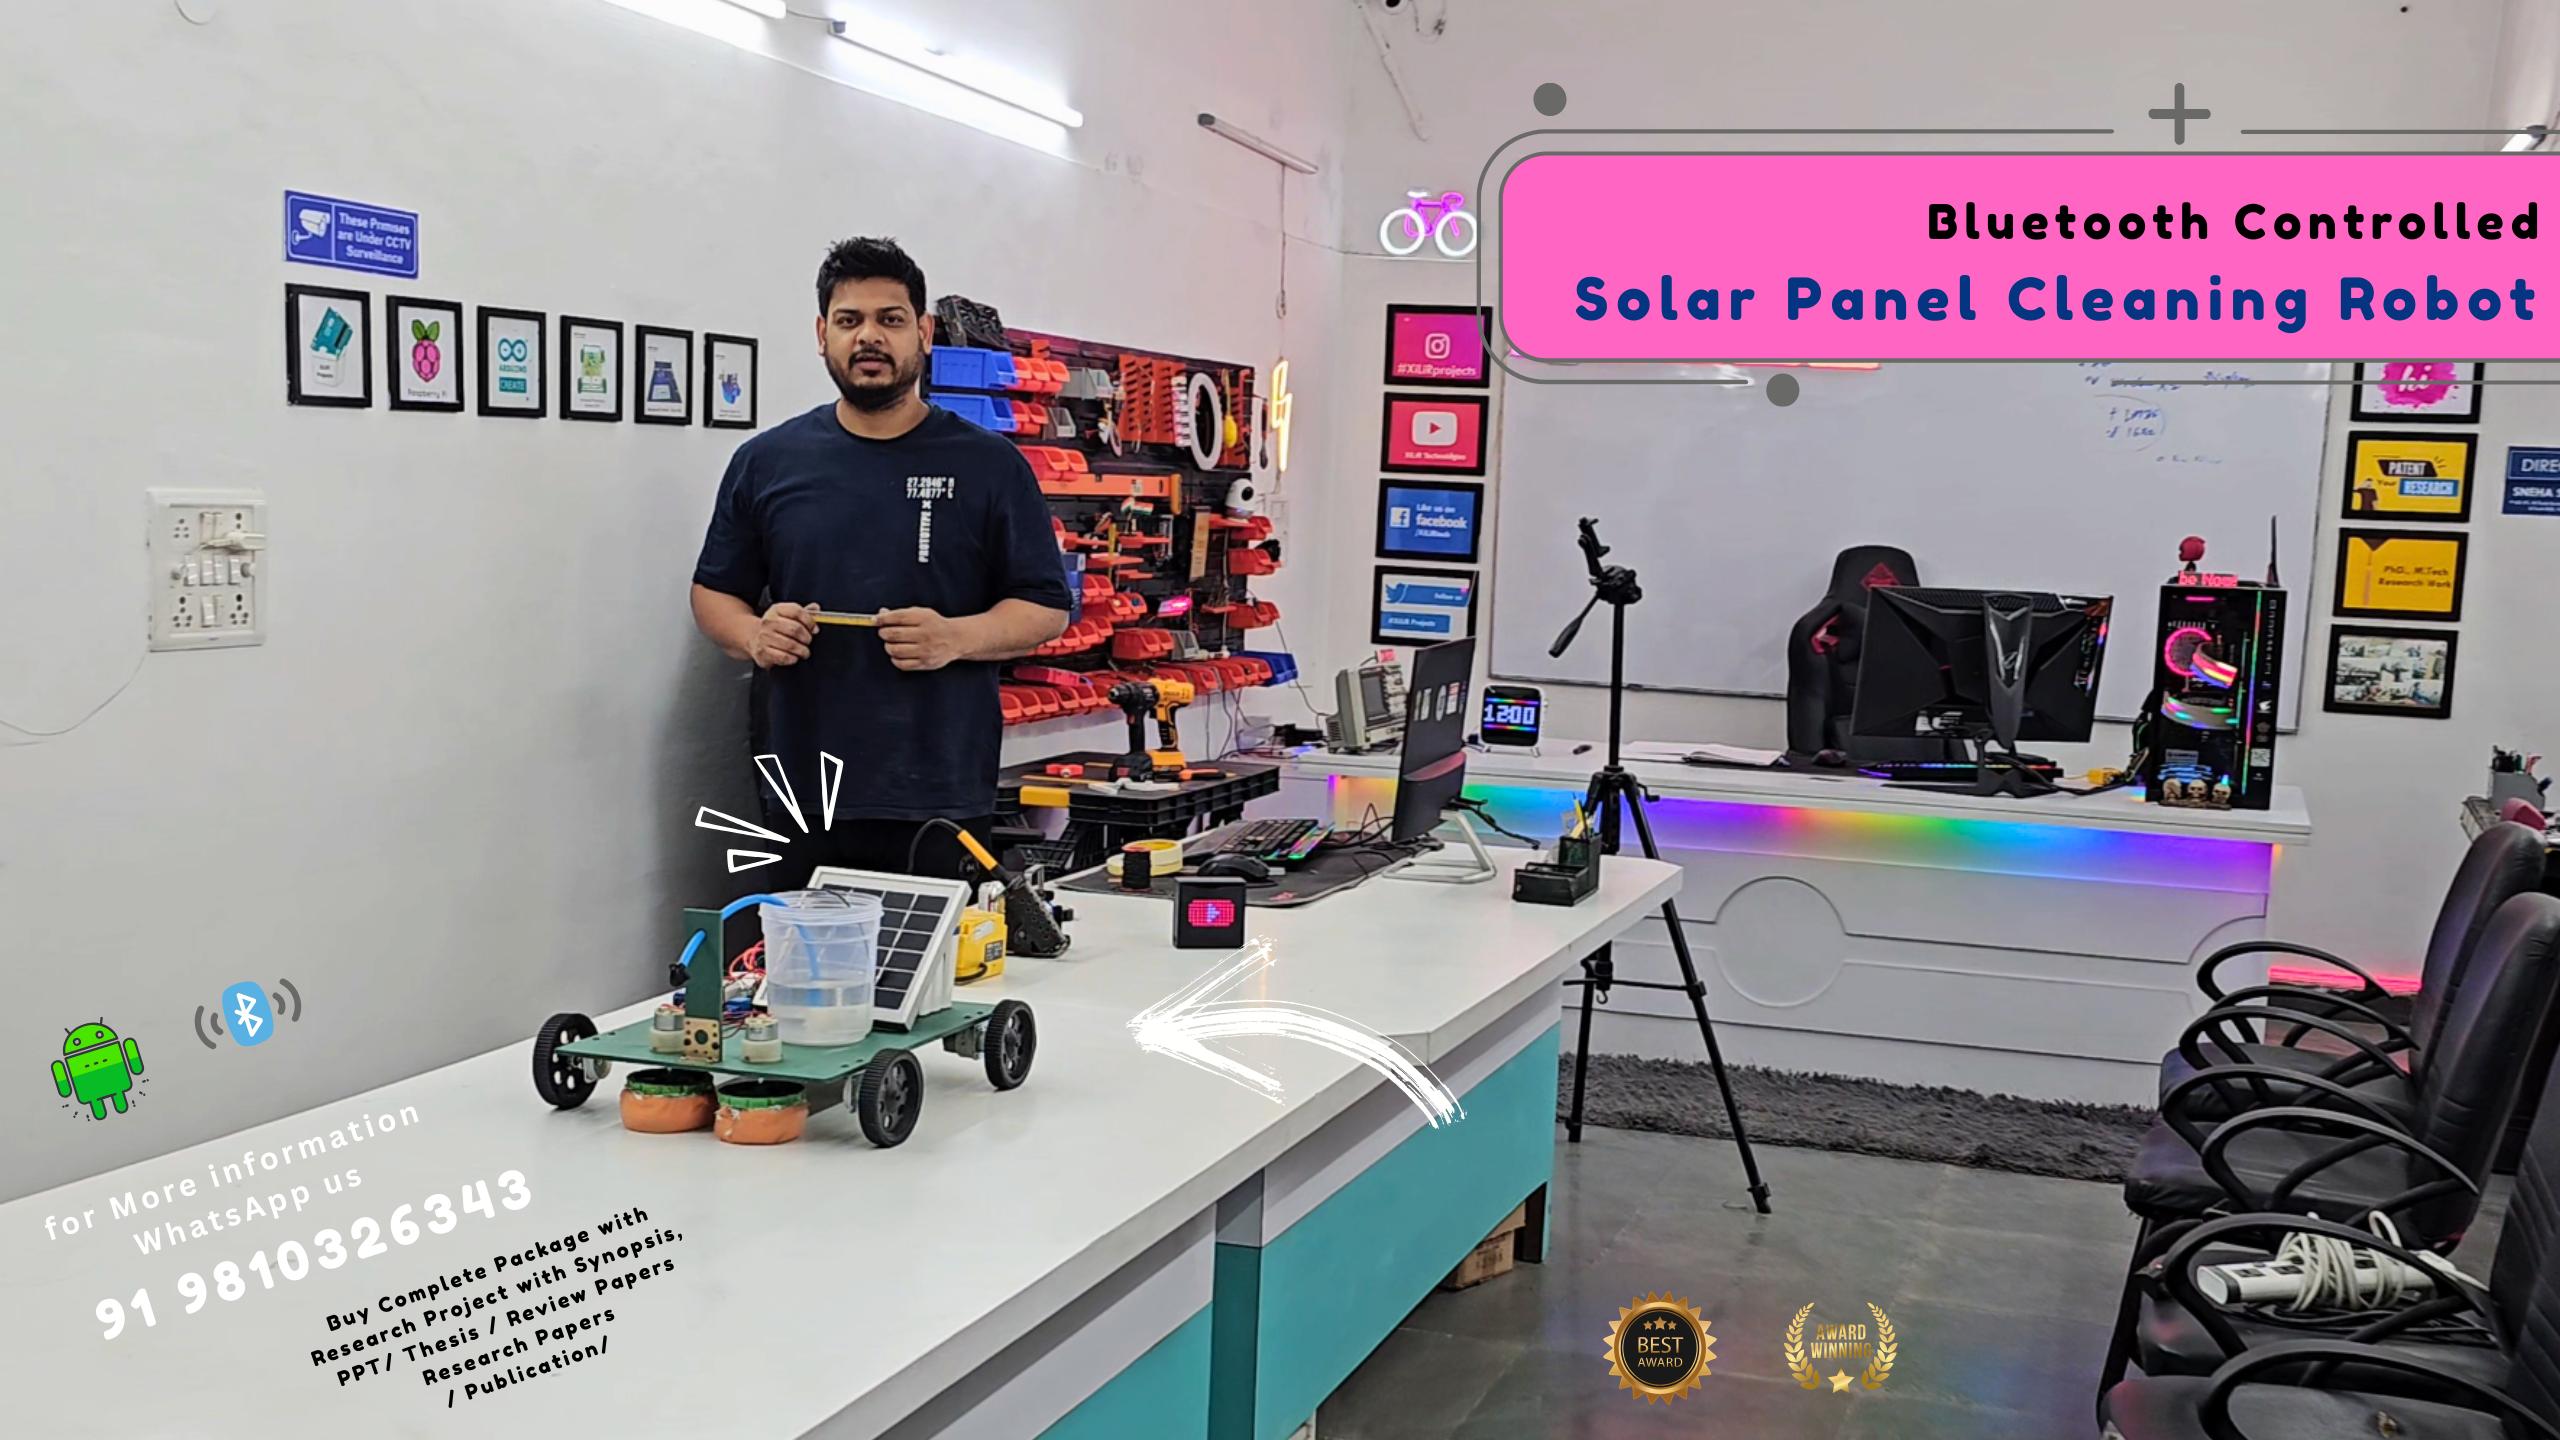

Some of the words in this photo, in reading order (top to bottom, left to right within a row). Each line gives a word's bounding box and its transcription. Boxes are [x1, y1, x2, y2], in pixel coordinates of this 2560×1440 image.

[338, 212, 368, 228] These
[369, 217, 410, 234] Premises
[337, 230, 353, 241] are
[355, 231, 383, 246] Under
[385, 236, 411, 250] CCTV
[346, 245, 403, 264] Surveillance
[2388, 462, 2427, 476] PATENT
[2521, 458, 2560, 473] DIRE
[2512, 486, 2554, 498] SNEHA
[1416, 513, 1468, 529] facebook
[918, 511, 932, 563] PROTOTYPE
[2378, 577, 2424, 588] Research
